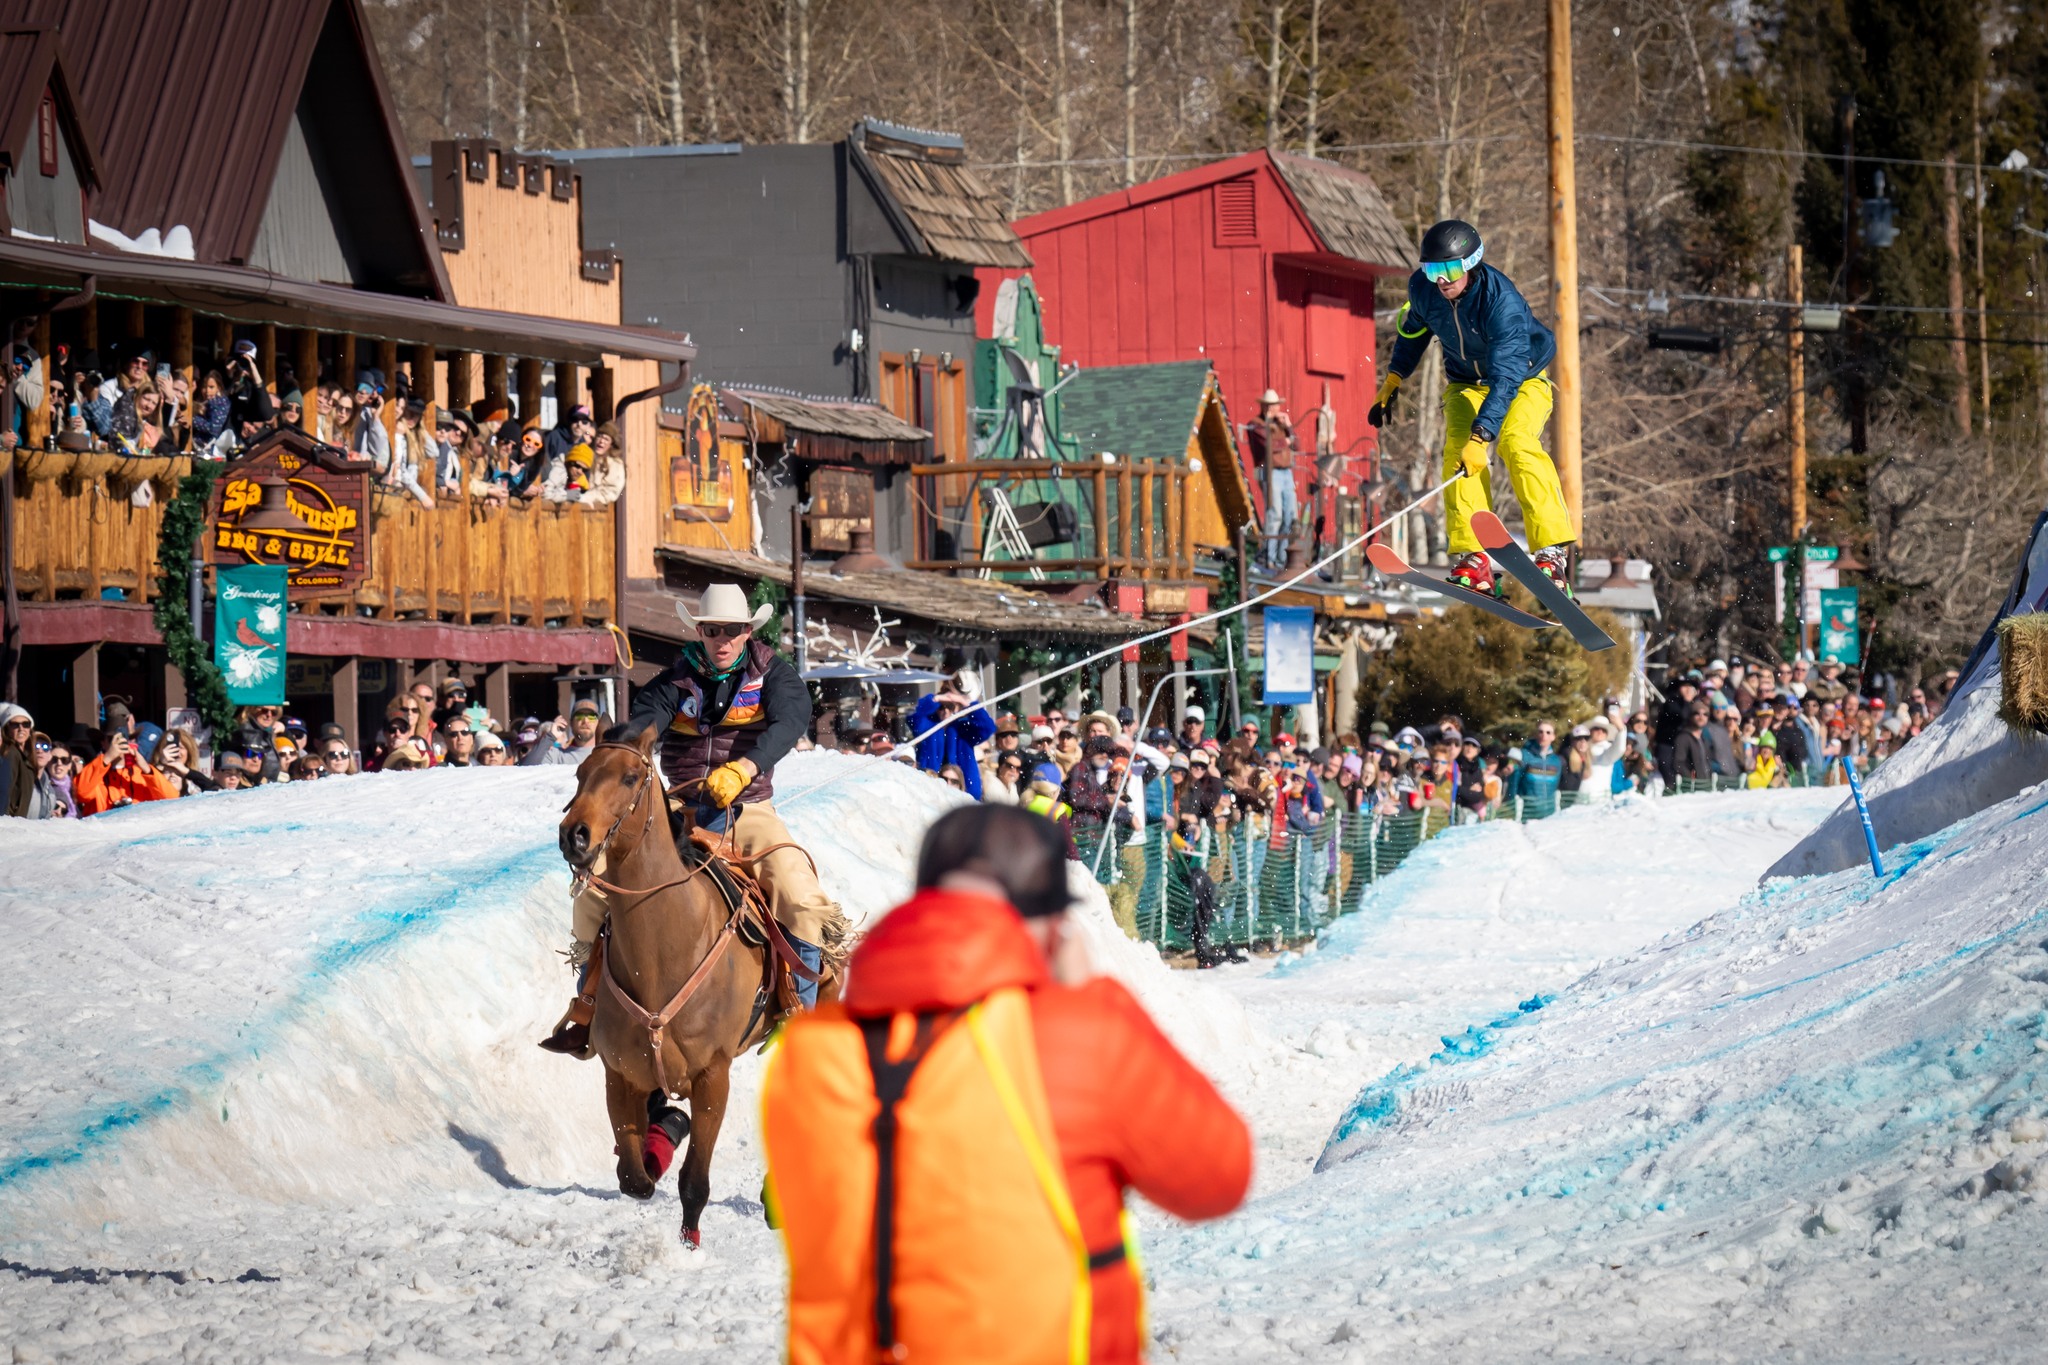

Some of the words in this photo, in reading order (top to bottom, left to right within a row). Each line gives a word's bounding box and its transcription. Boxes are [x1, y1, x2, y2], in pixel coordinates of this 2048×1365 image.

[223, 479, 357, 532] Sabrush
[217, 530, 258, 552] BBQ
[265, 538, 282, 555] &
[289, 541, 350, 566] GRILL
[222, 584, 280, 603] Greetings
[296, 577, 338, 585] COLORADO
[1850, 772, 1872, 825] Hero
